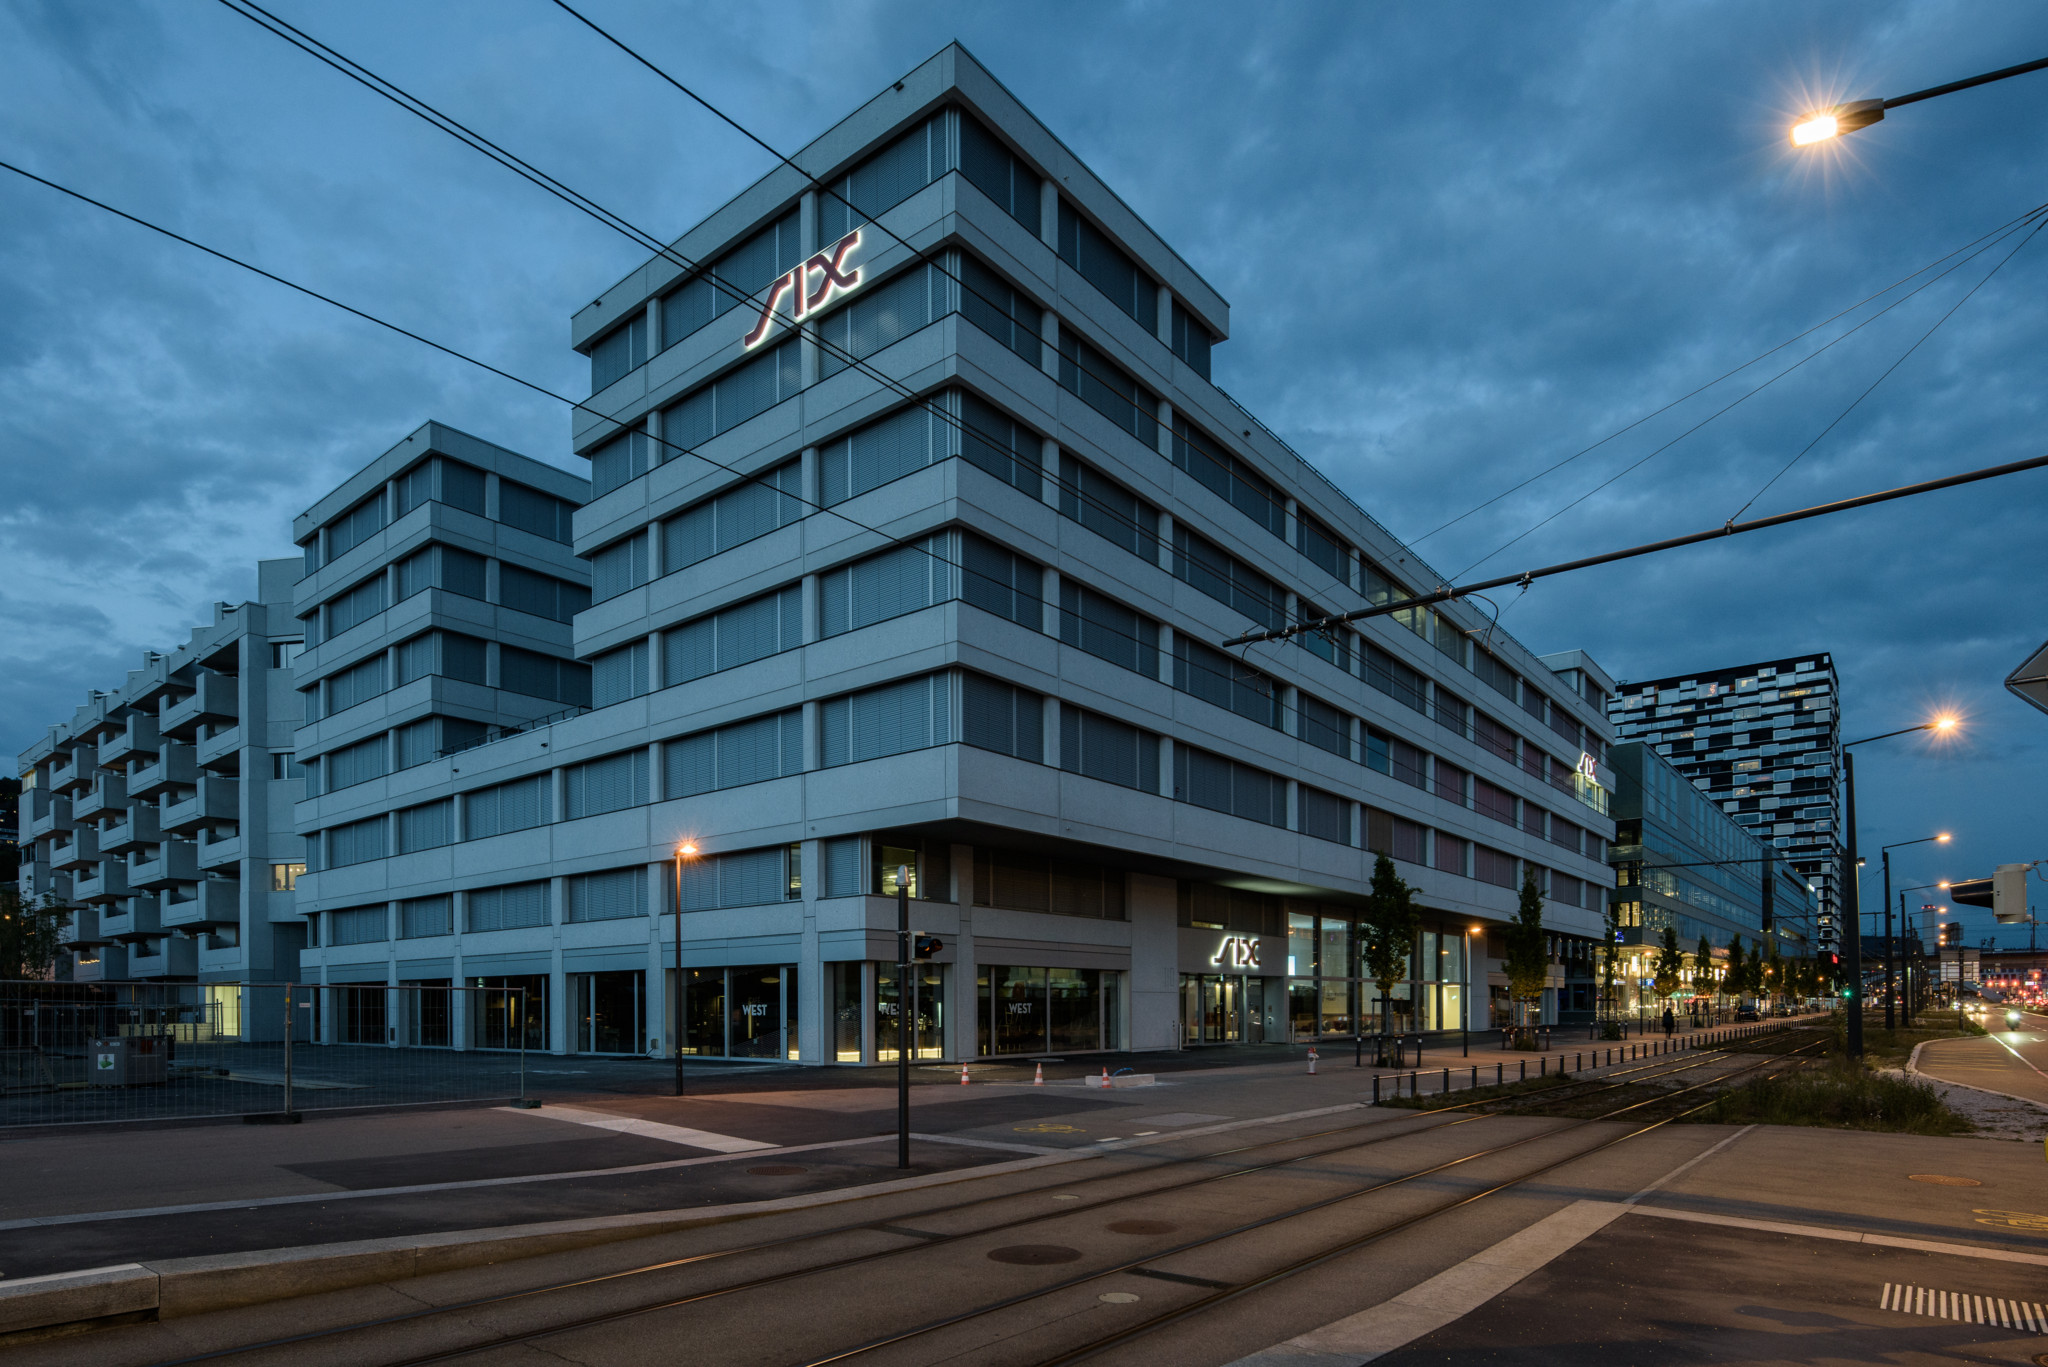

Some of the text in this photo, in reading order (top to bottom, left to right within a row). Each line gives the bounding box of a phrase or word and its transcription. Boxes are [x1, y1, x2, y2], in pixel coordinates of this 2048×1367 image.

[744, 231, 859, 348] SIX
[1213, 937, 1262, 966] SIX
[742, 1004, 768, 1016] WEST
[1008, 1002, 1033, 1014] WEST
